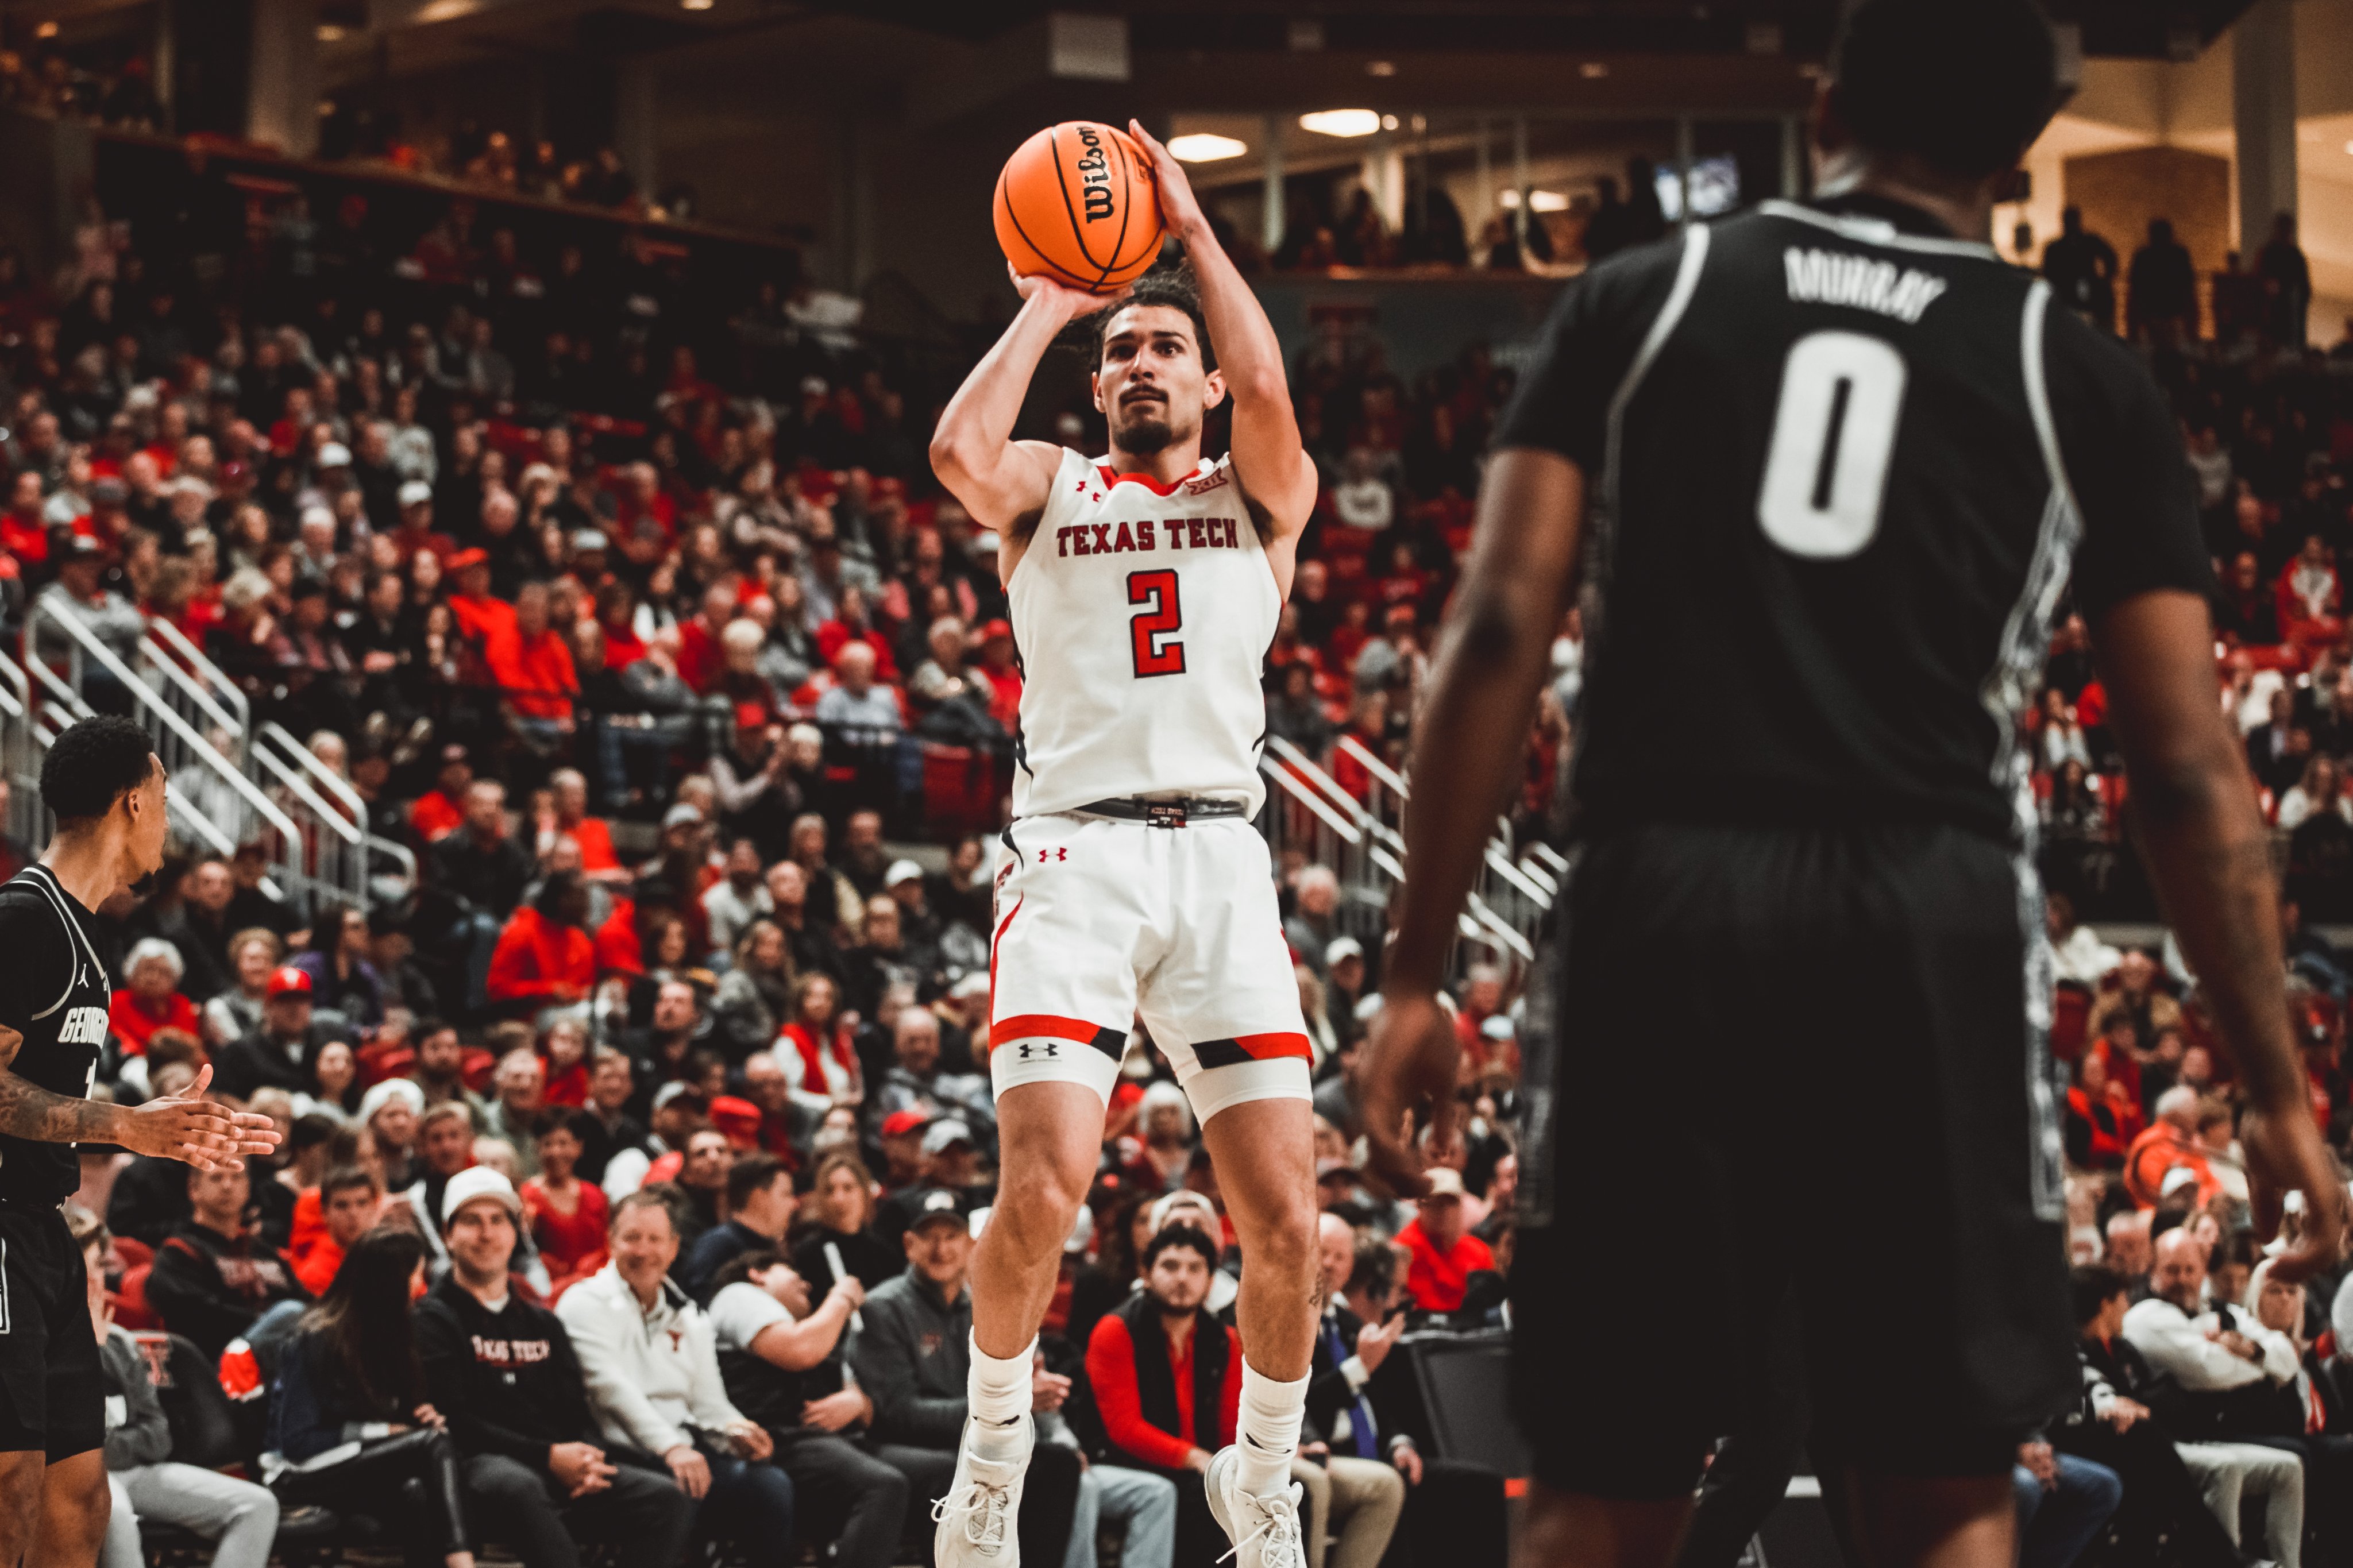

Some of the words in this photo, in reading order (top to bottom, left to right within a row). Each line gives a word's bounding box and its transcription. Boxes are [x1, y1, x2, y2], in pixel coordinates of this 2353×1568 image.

[1076, 126, 1114, 224] Wilson
[1784, 246, 1947, 325] MURRAY
[1754, 329, 1910, 561] 0
[1056, 521, 1156, 557] TEXAS
[1163, 517, 1239, 549] TECH
[1126, 568, 1186, 679] 2
